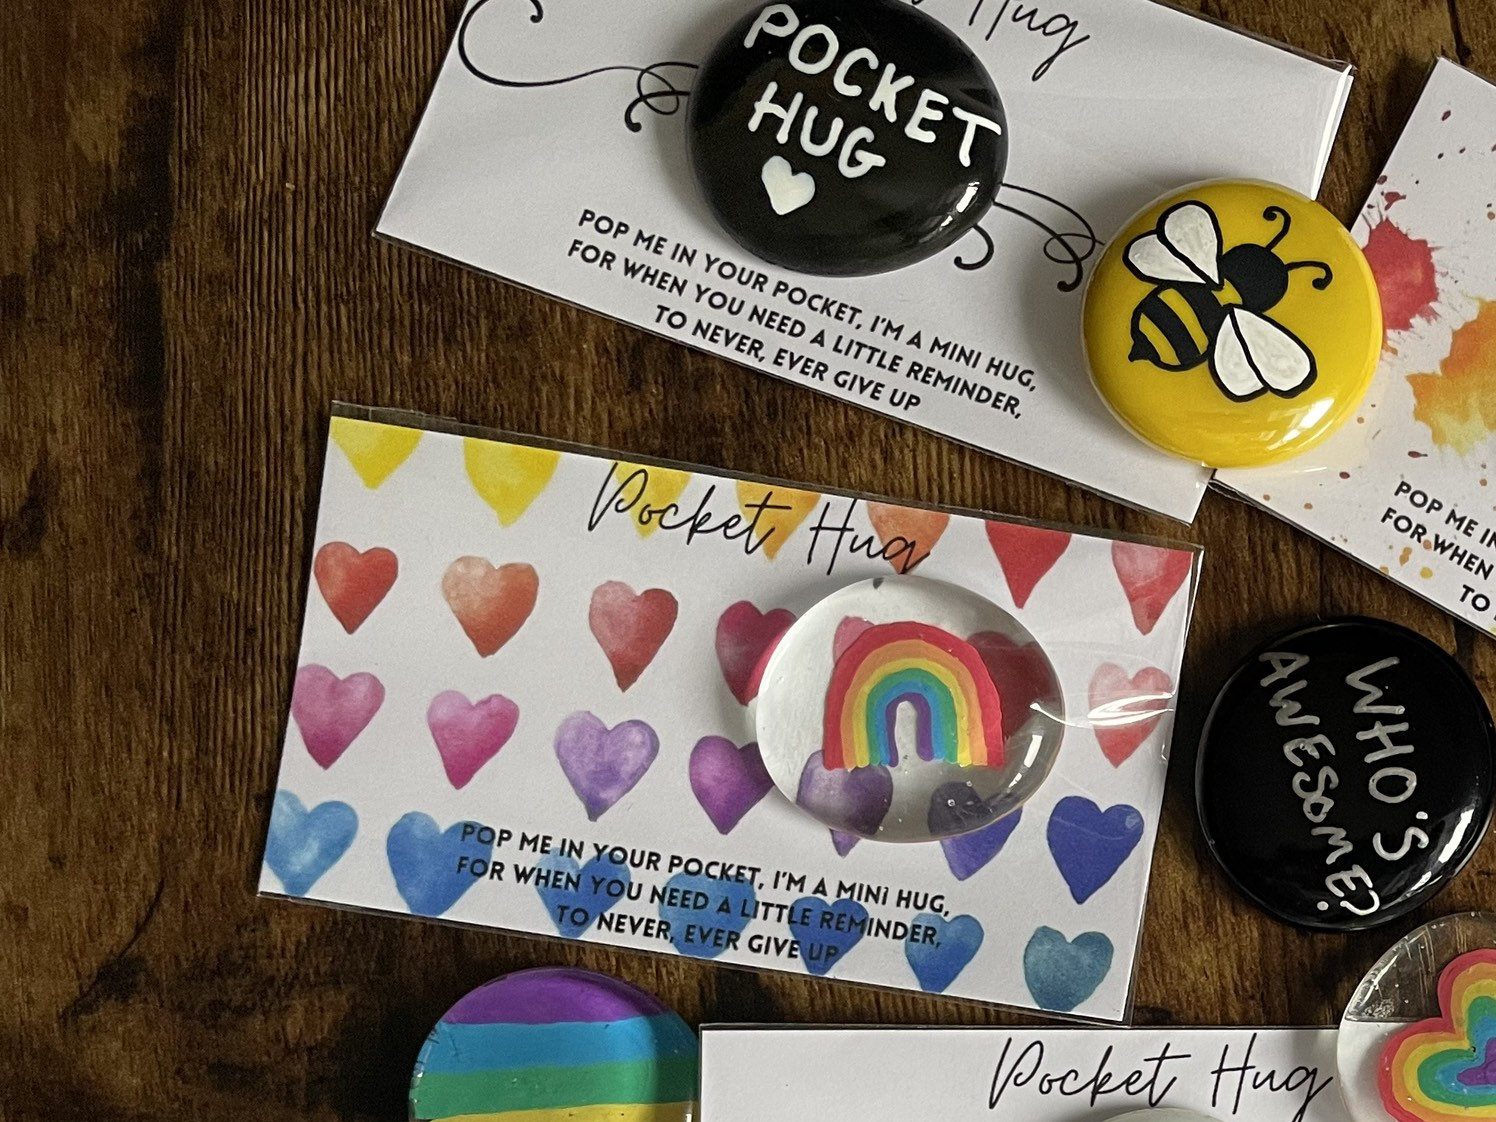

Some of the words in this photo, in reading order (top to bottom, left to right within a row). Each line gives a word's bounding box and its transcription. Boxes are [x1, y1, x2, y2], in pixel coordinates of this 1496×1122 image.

[744, 3, 1001, 167] POCKET
[748, 81, 886, 178] HUG
[567, 238, 616, 270] FOR
[623, 257, 688, 296] WHEN
[694, 283, 745, 315] YOU
[747, 304, 806, 338] NEED
[809, 328, 824, 347] A
[832, 334, 903, 373] LITTLE
[905, 360, 1021, 419] REMINDER,
[578, 208, 629, 238] POP
[632, 228, 667, 255] ME
[670, 242, 697, 266] IN
[704, 253, 768, 292] YOUR
[771, 280, 862, 329] POCKET,
[869, 315, 904, 341] I'M
[905, 330, 921, 349] A
[928, 336, 981, 368] MINI
[984, 356, 1035, 391] HUG,
[654, 304, 687, 329] TO
[691, 318, 765, 362] NEVER,
[772, 347, 828, 381] EVER
[833, 370, 885, 400] GIVE
[889, 388, 920, 410] UP
[588, 461, 792, 555] Pocket
[1393, 480, 1443, 513] POP
[1444, 508, 1478, 537] ME
[1259, 651, 1381, 917] AWESOME?
[1346, 656, 1429, 862] WHO'S
[460, 822, 512, 847] POP
[518, 831, 552, 854] ME
[558, 837, 584, 859] IN
[592, 842, 661, 871] YOUR
[667, 854, 764, 890] POCKET,
[772, 870, 806, 893] I'M
[811, 876, 827, 896] A
[835, 879, 889, 905] MINI
[895, 888, 949, 921] HUG,
[988, 1037, 1191, 1108] Pocket
